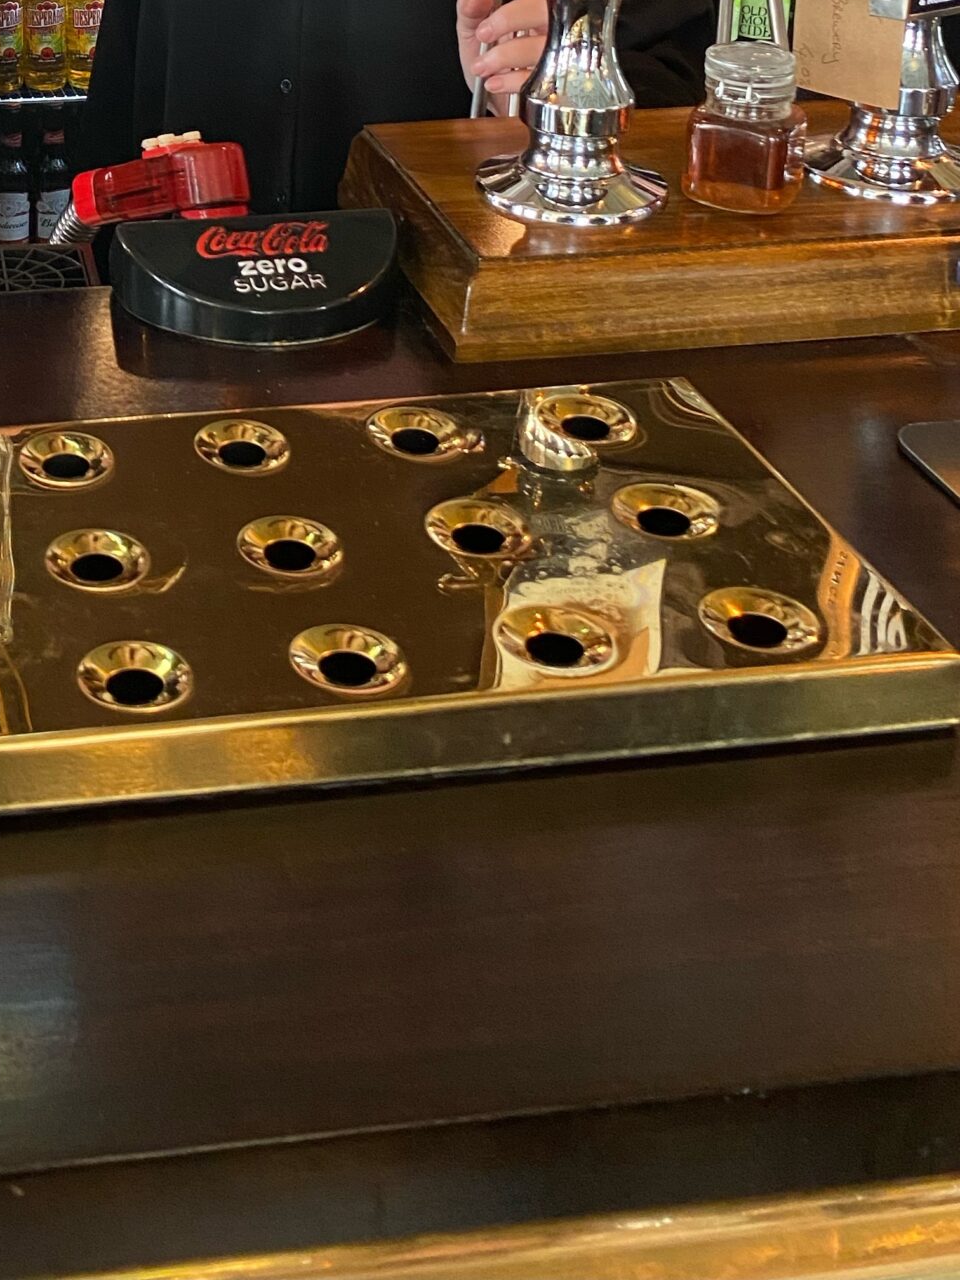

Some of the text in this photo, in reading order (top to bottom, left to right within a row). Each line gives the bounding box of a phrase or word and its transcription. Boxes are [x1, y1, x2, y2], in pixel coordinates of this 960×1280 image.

[74, 8, 102, 28] DESPER
[741, 5, 768, 17] OLD
[740, 25, 771, 37] CIDE
[196, 221, 330, 259] Coca-Cola
[238, 257, 308, 276] zero
[233, 274, 327, 293] SUGAR
